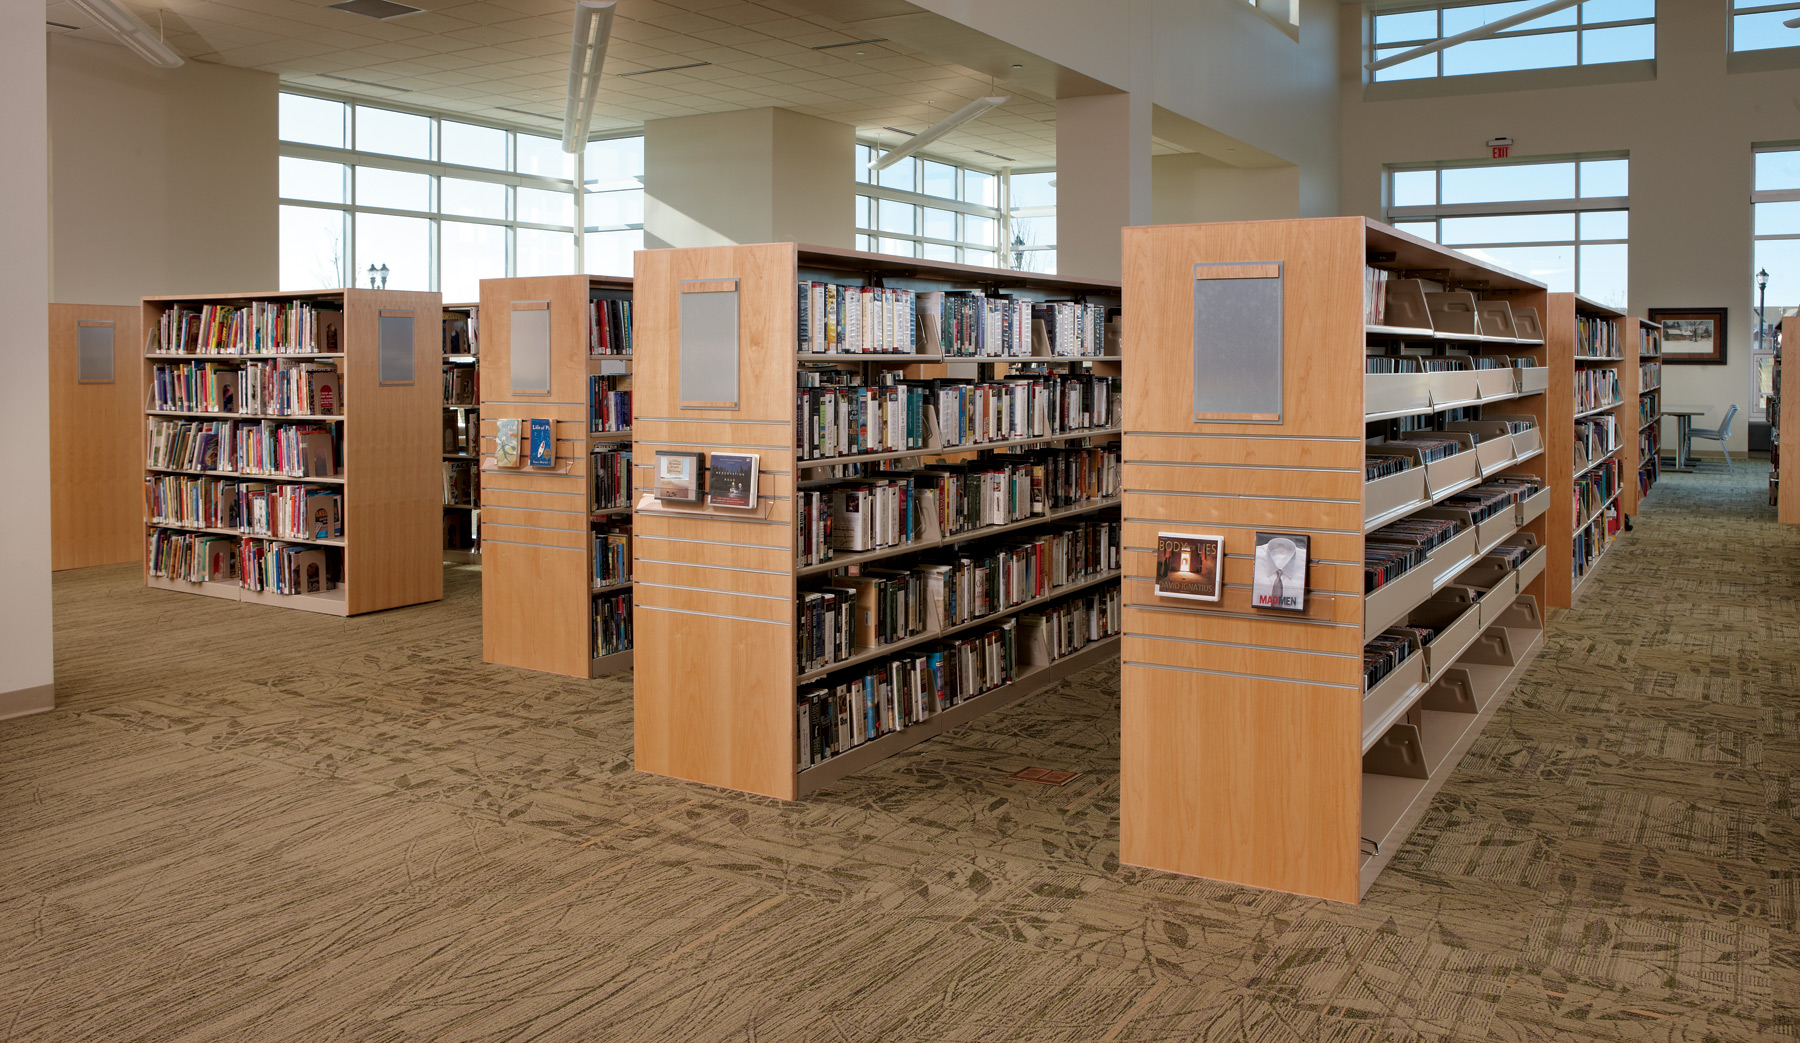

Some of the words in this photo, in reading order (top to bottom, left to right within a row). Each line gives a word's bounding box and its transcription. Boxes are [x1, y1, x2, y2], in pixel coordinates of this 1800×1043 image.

[1492, 146, 1509, 158] EXIT
[1159, 540, 1188, 552] BODY
[1197, 543, 1217, 555] LIES
[1159, 580, 1180, 589] DAVID
[1181, 582, 1213, 593] IGNATIUS
